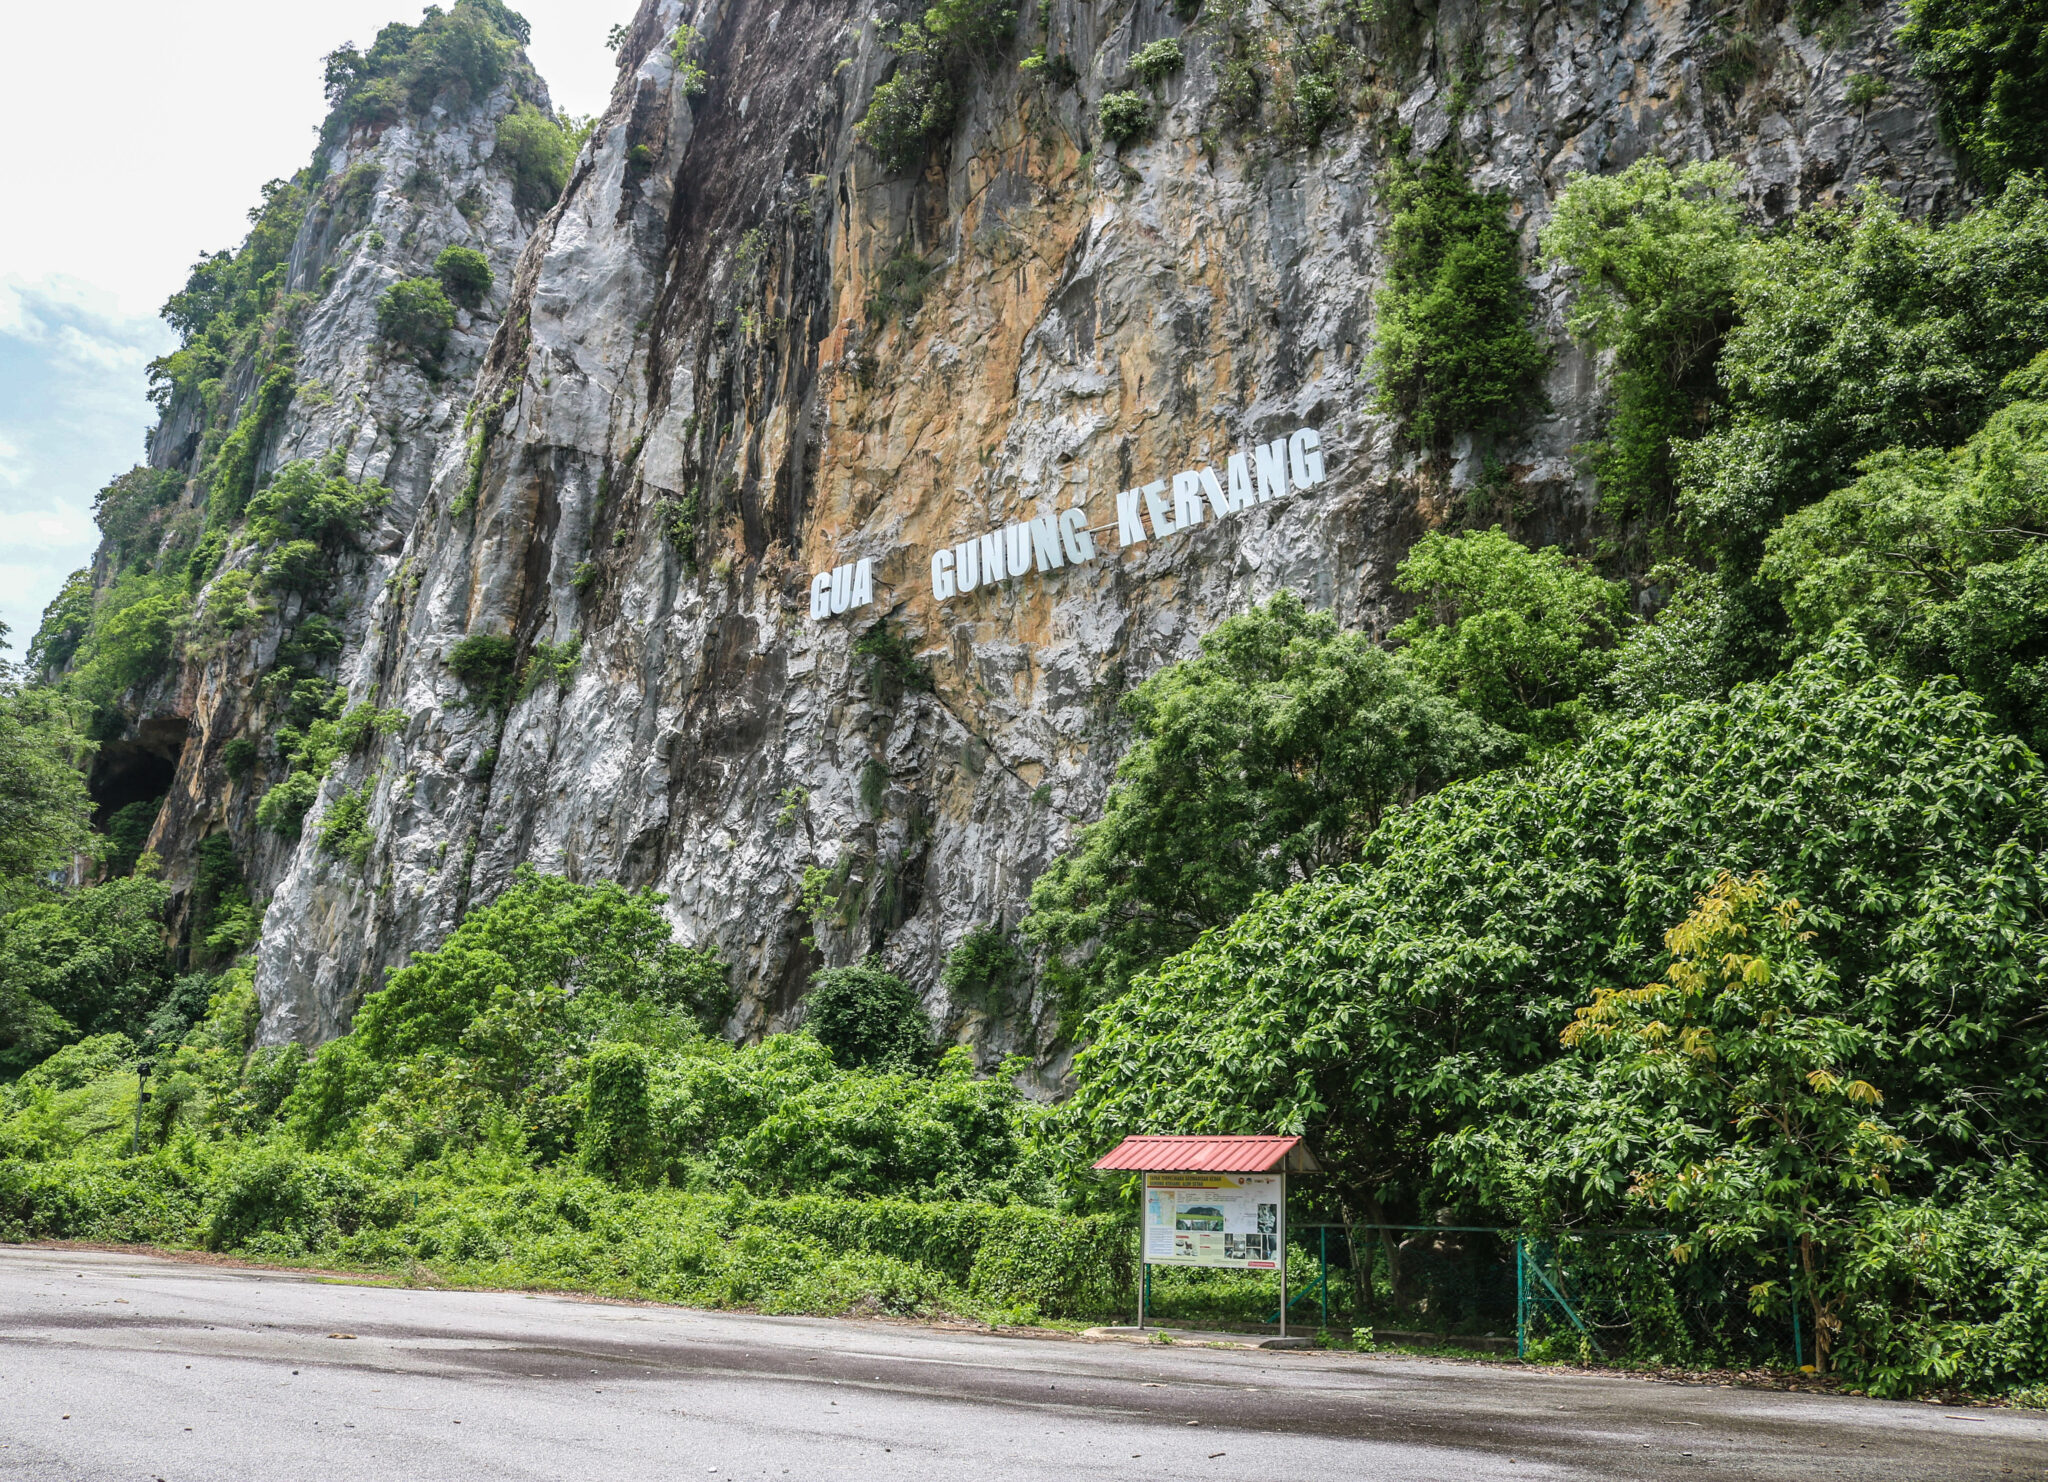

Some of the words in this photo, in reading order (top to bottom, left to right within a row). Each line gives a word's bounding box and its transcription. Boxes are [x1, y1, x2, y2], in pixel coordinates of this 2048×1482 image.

[810, 557, 874, 621] GUA
[931, 507, 1096, 601] GUNUNG
[1117, 427, 1326, 548] KERIANG
